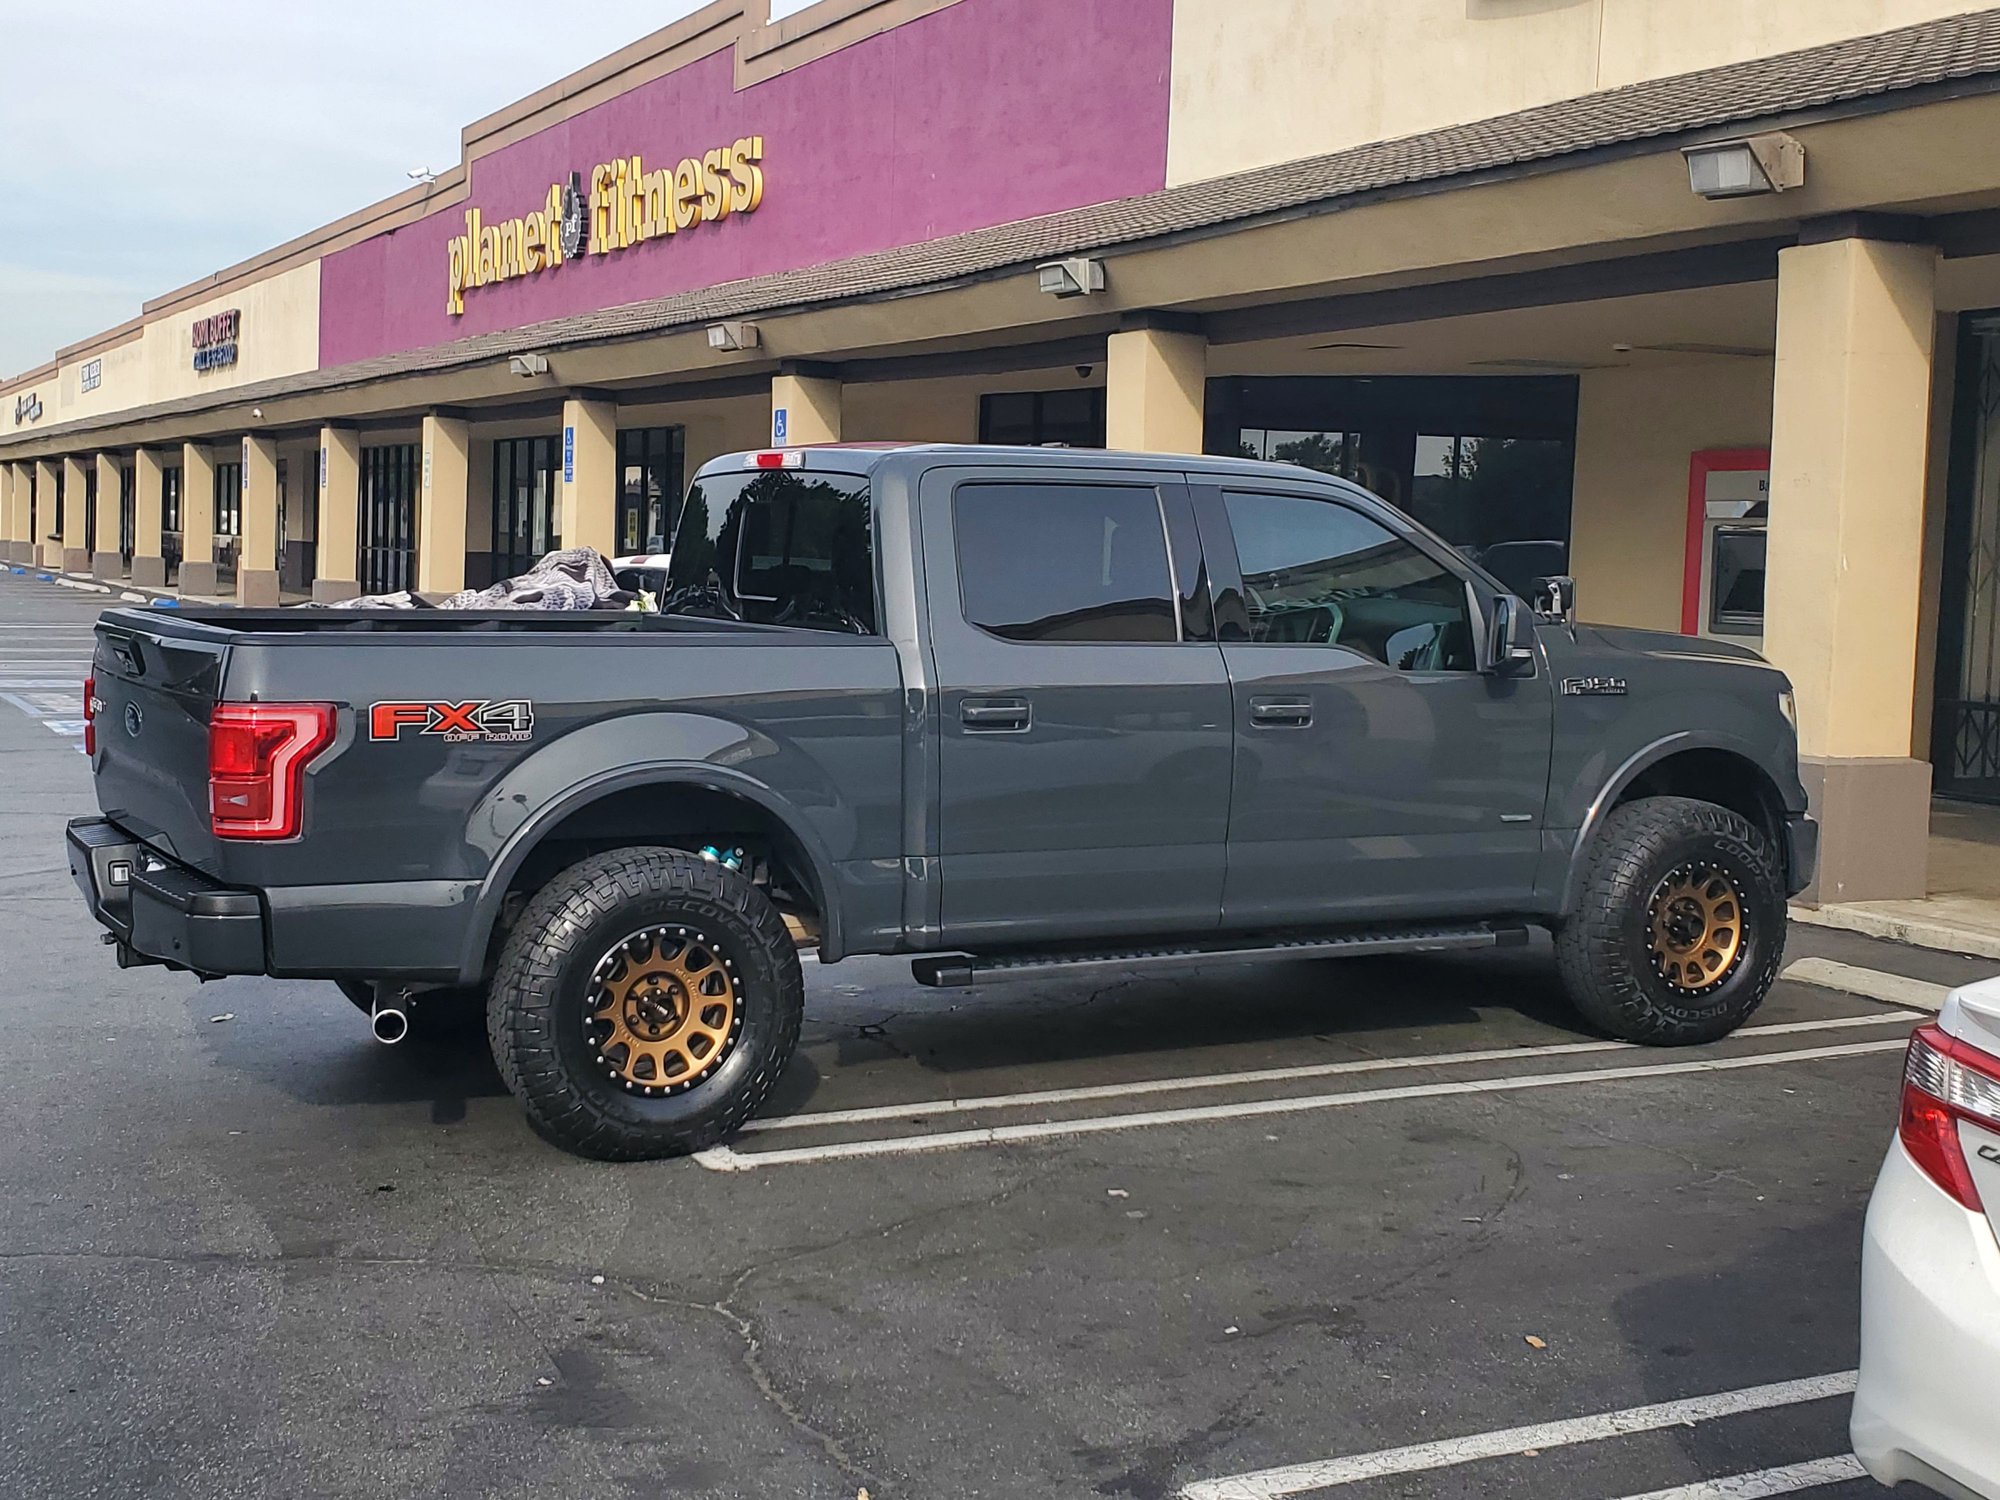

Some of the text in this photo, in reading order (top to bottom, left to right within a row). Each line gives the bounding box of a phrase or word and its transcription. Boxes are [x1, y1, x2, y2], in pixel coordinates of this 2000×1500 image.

[447, 136, 764, 315] planet fitness
[369, 700, 534, 741] FX4
[443, 733, 532, 742] OFF ROAD
